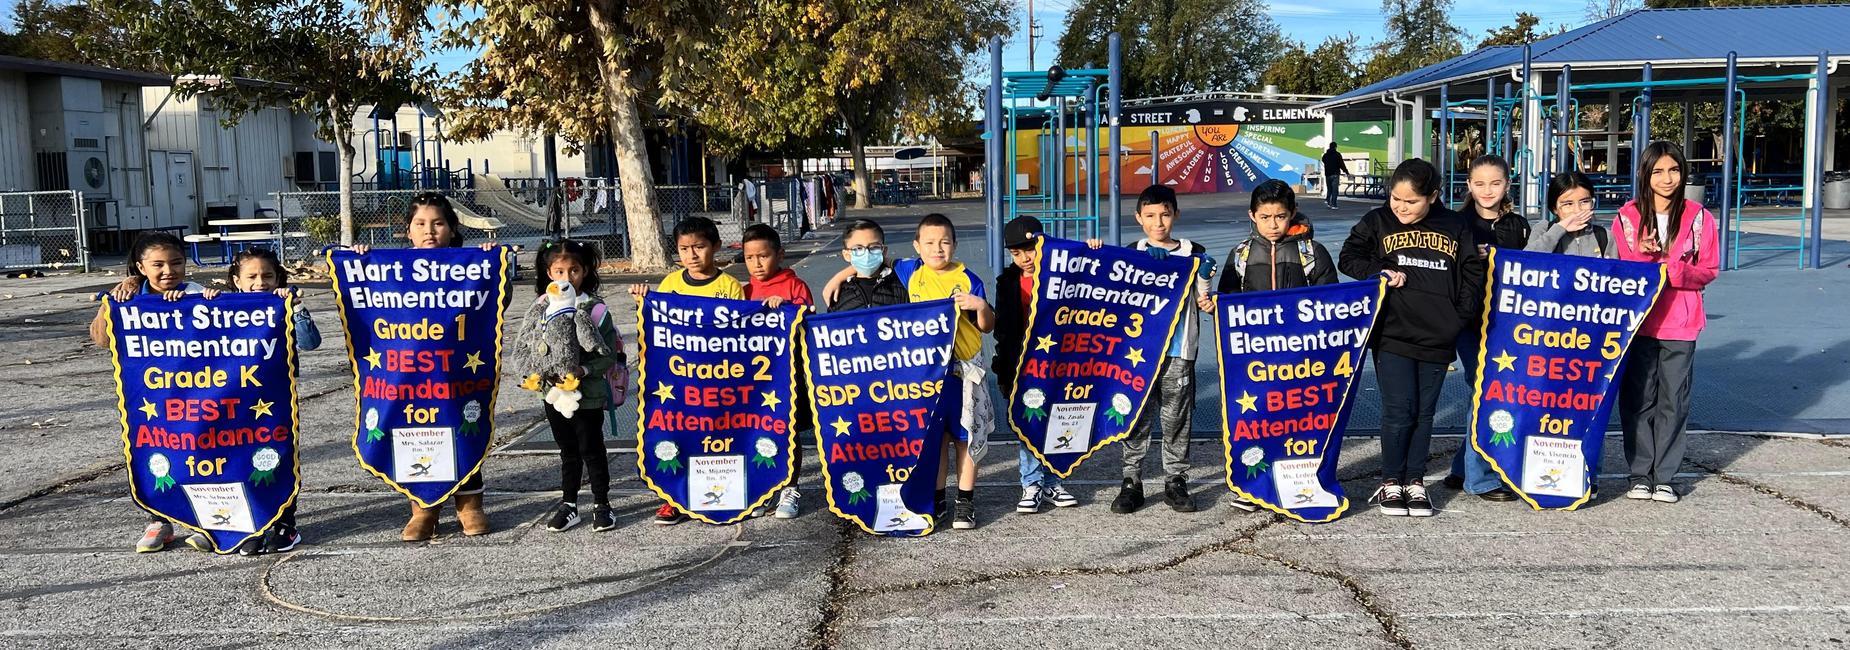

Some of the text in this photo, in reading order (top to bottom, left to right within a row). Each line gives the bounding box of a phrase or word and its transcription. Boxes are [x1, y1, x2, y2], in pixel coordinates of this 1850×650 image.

[1130, 112, 1173, 124] STREET
[1246, 124, 1286, 134] INSPIRING
[1160, 140, 1193, 160] GRATEFUL
[1166, 132, 1190, 145] HAPPY
[1211, 133, 1228, 142] ARE
[1241, 137, 1280, 158] IMPORTANT
[1244, 131, 1273, 145] SPECIAL
[1166, 145, 1197, 171] AWESOME
[1179, 149, 1205, 180] LEADERS
[1203, 153, 1213, 183] KIND
[1220, 151, 1234, 186] LOVED
[1228, 148, 1257, 182] CREATIVE
[1235, 143, 1271, 169] DREAMERS
[343, 259, 491, 283] Hart Street
[1050, 249, 1179, 289] Hart Street
[1502, 261, 1648, 297] Hart Street
[349, 286, 489, 311] Elementary
[1046, 277, 1170, 316] Elementary
[120, 304, 276, 330] Hart Street
[651, 300, 785, 331] Hart Street
[1055, 306, 1144, 338] Grade 3
[1228, 296, 1371, 328] Hart Street
[1499, 289, 1644, 332] Elementary
[373, 313, 467, 341] Grade 1
[812, 313, 950, 348] Hart Street
[125, 335, 278, 360] Elementary
[653, 326, 786, 356] Elementary
[1060, 333, 1122, 356] BEST
[1230, 326, 1369, 355] Elementary
[1513, 323, 1622, 360] Grade 5
[386, 349, 455, 373] BEST
[669, 355, 773, 381] Grade 2
[818, 344, 951, 377] Elementary
[1247, 351, 1353, 383] Grade 4
[1527, 355, 1602, 383] BEST
[143, 365, 263, 389] Grade K
[363, 375, 491, 400] Attendance
[1023, 357, 1146, 392] Attendance
[684, 385, 755, 407] BEST
[815, 384, 861, 407] SDP
[1064, 382, 1094, 401] for
[1266, 382, 1338, 413] BEST
[165, 398, 241, 422] BEST
[403, 403, 439, 424] for
[648, 409, 786, 434] Attendance
[858, 407, 928, 434] BEST
[136, 424, 289, 450] Attendance
[1539, 414, 1573, 435] for
[701, 435, 734, 453] for
[1284, 437, 1317, 457] for
[1533, 439, 1578, 449] November
[185, 455, 227, 477] for
